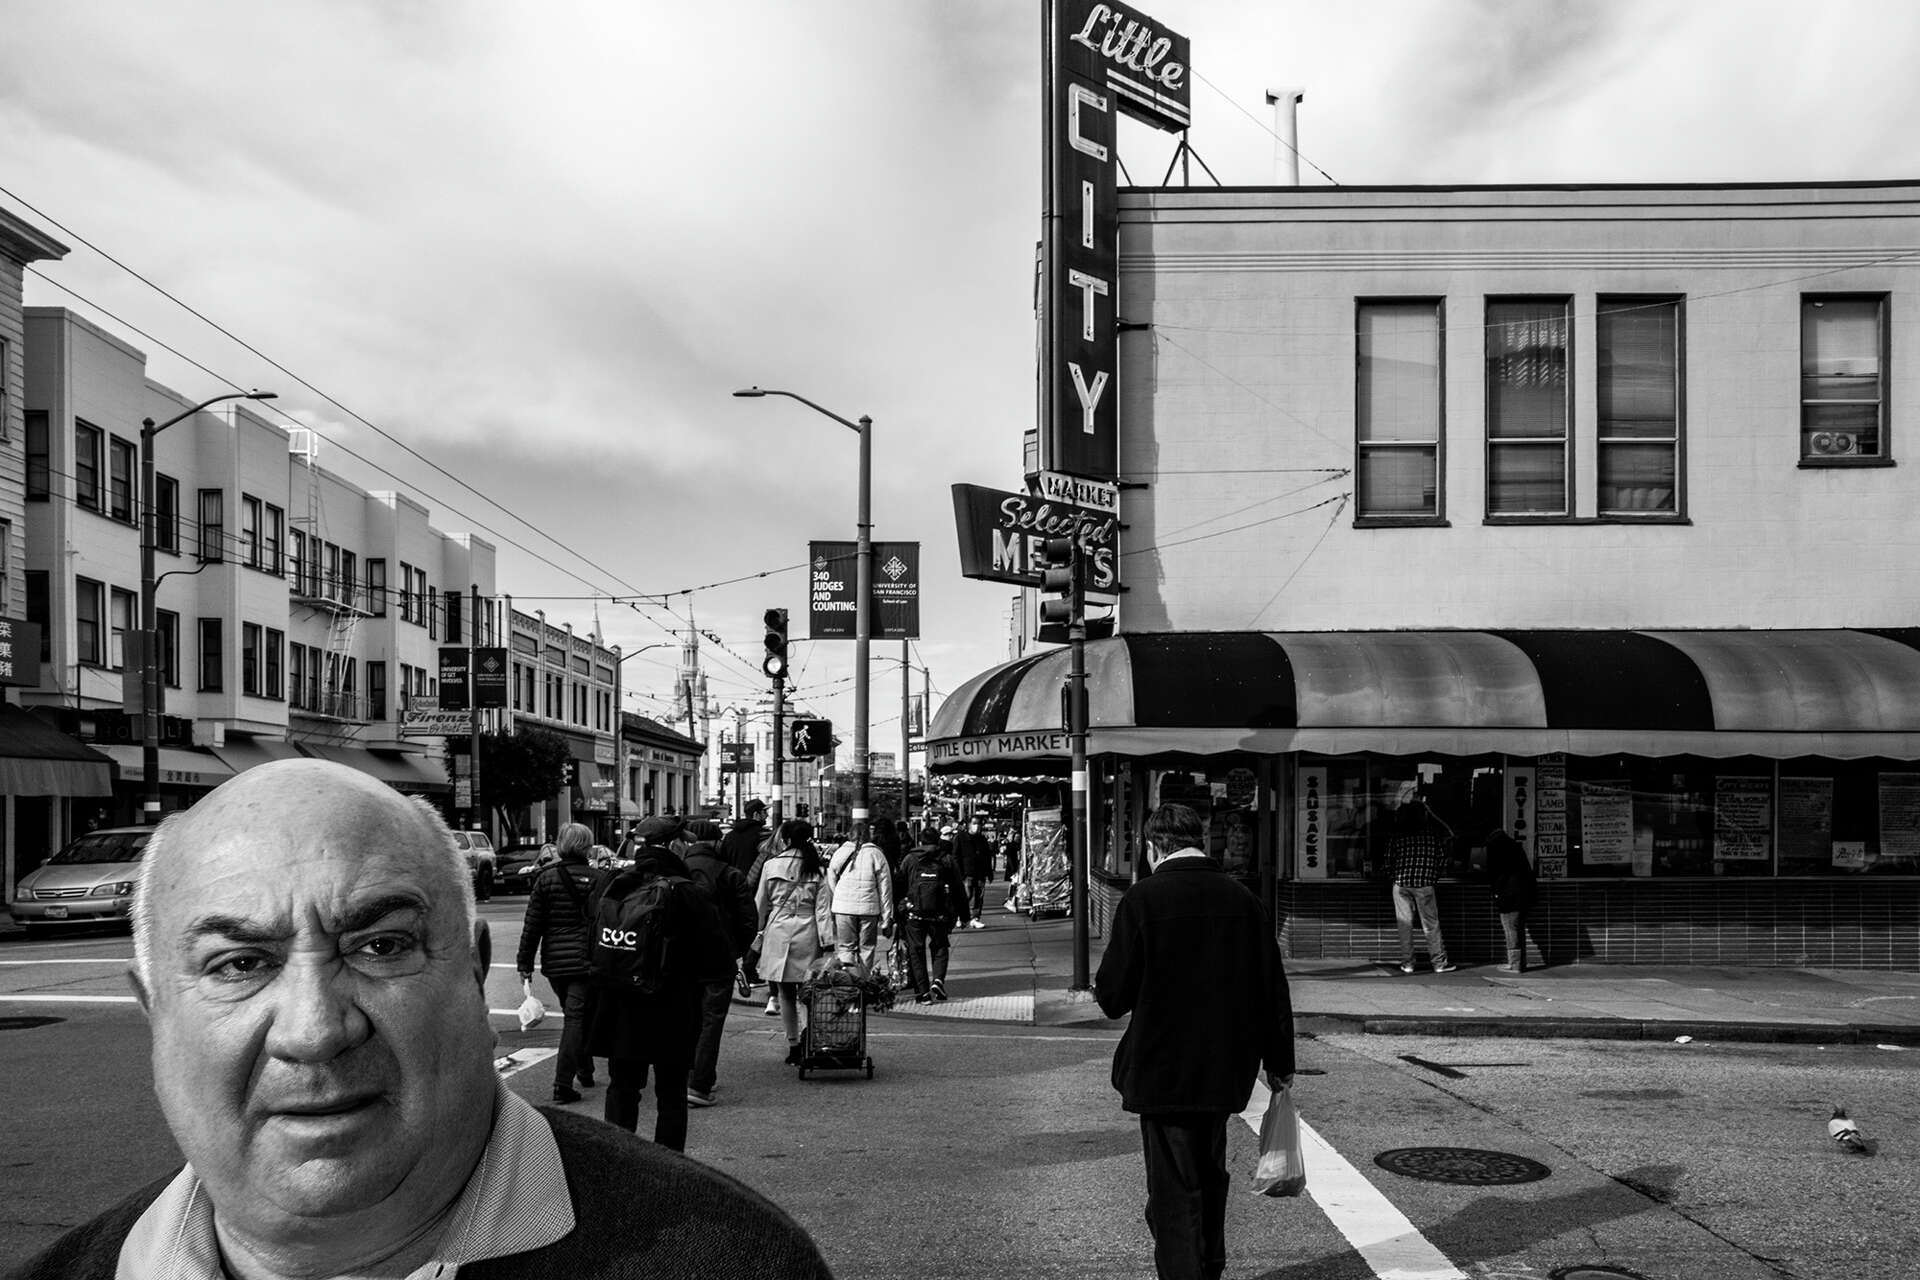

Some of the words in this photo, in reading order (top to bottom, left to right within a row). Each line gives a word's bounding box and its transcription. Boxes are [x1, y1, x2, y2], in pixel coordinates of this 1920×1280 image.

[1070, 3, 1184, 90] Little
[1068, 82, 1110, 435] CITY
[1046, 476, 1116, 508] MARKET
[1000, 496, 1115, 545] Selected
[992, 528, 1114, 589] MES
[812, 571, 830, 581] 340
[812, 581, 844, 591] JUDGES
[812, 591, 831, 601] AND
[812, 601, 858, 611] COUNTING.
[962, 739, 992, 756] CITY
[997, 734, 1071, 754] MARKET
[1539, 799, 1565, 808] LAMB
[1540, 845, 1566, 854] VEAL
